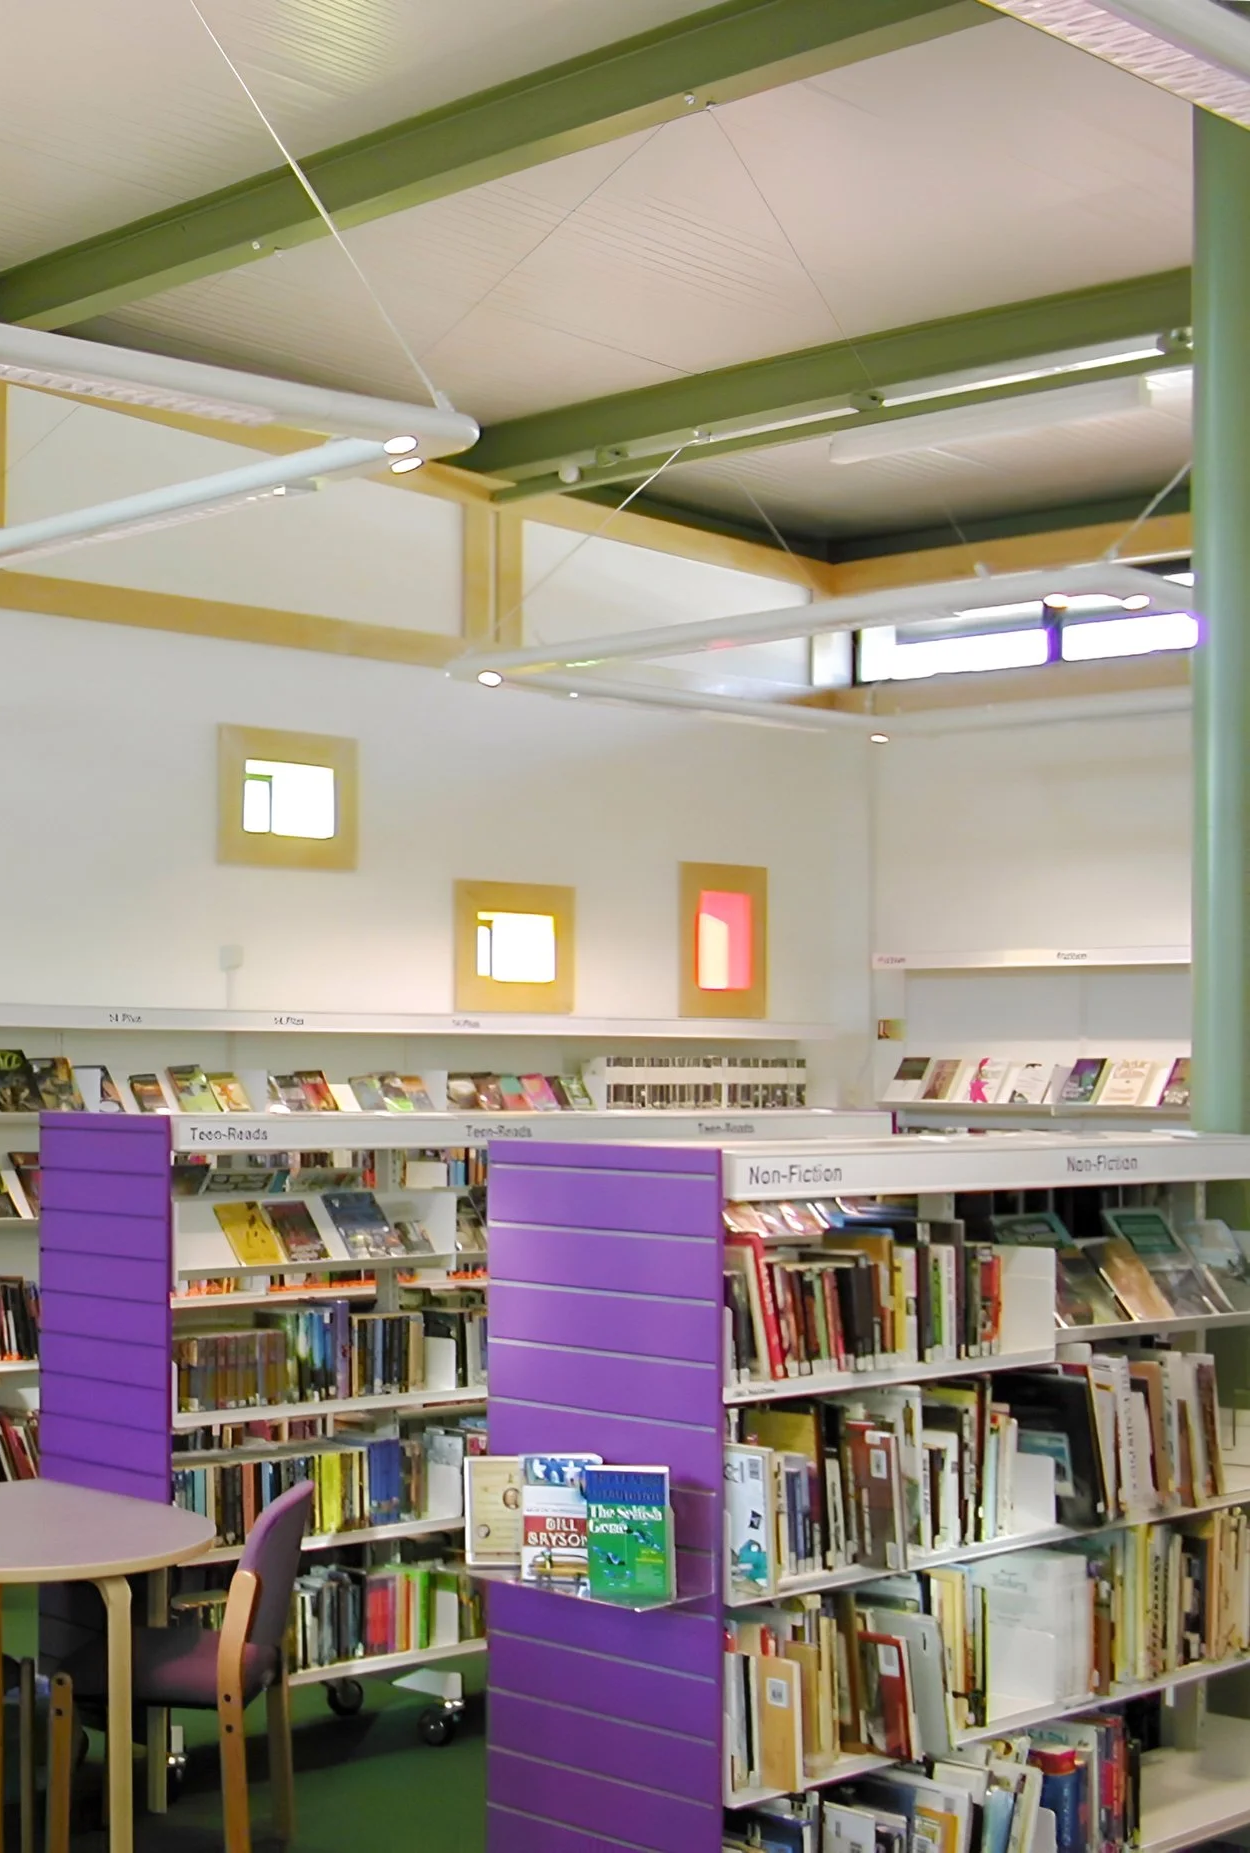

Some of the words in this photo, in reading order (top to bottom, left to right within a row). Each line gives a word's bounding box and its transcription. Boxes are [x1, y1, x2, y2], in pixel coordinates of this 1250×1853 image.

[1066, 1154, 1139, 1172] Non-Fiction
[749, 1163, 843, 1185] Non-Fiction
[589, 1503, 615, 1519] The
[545, 1517, 579, 1532] BILL
[589, 1519, 628, 1534] Gene
